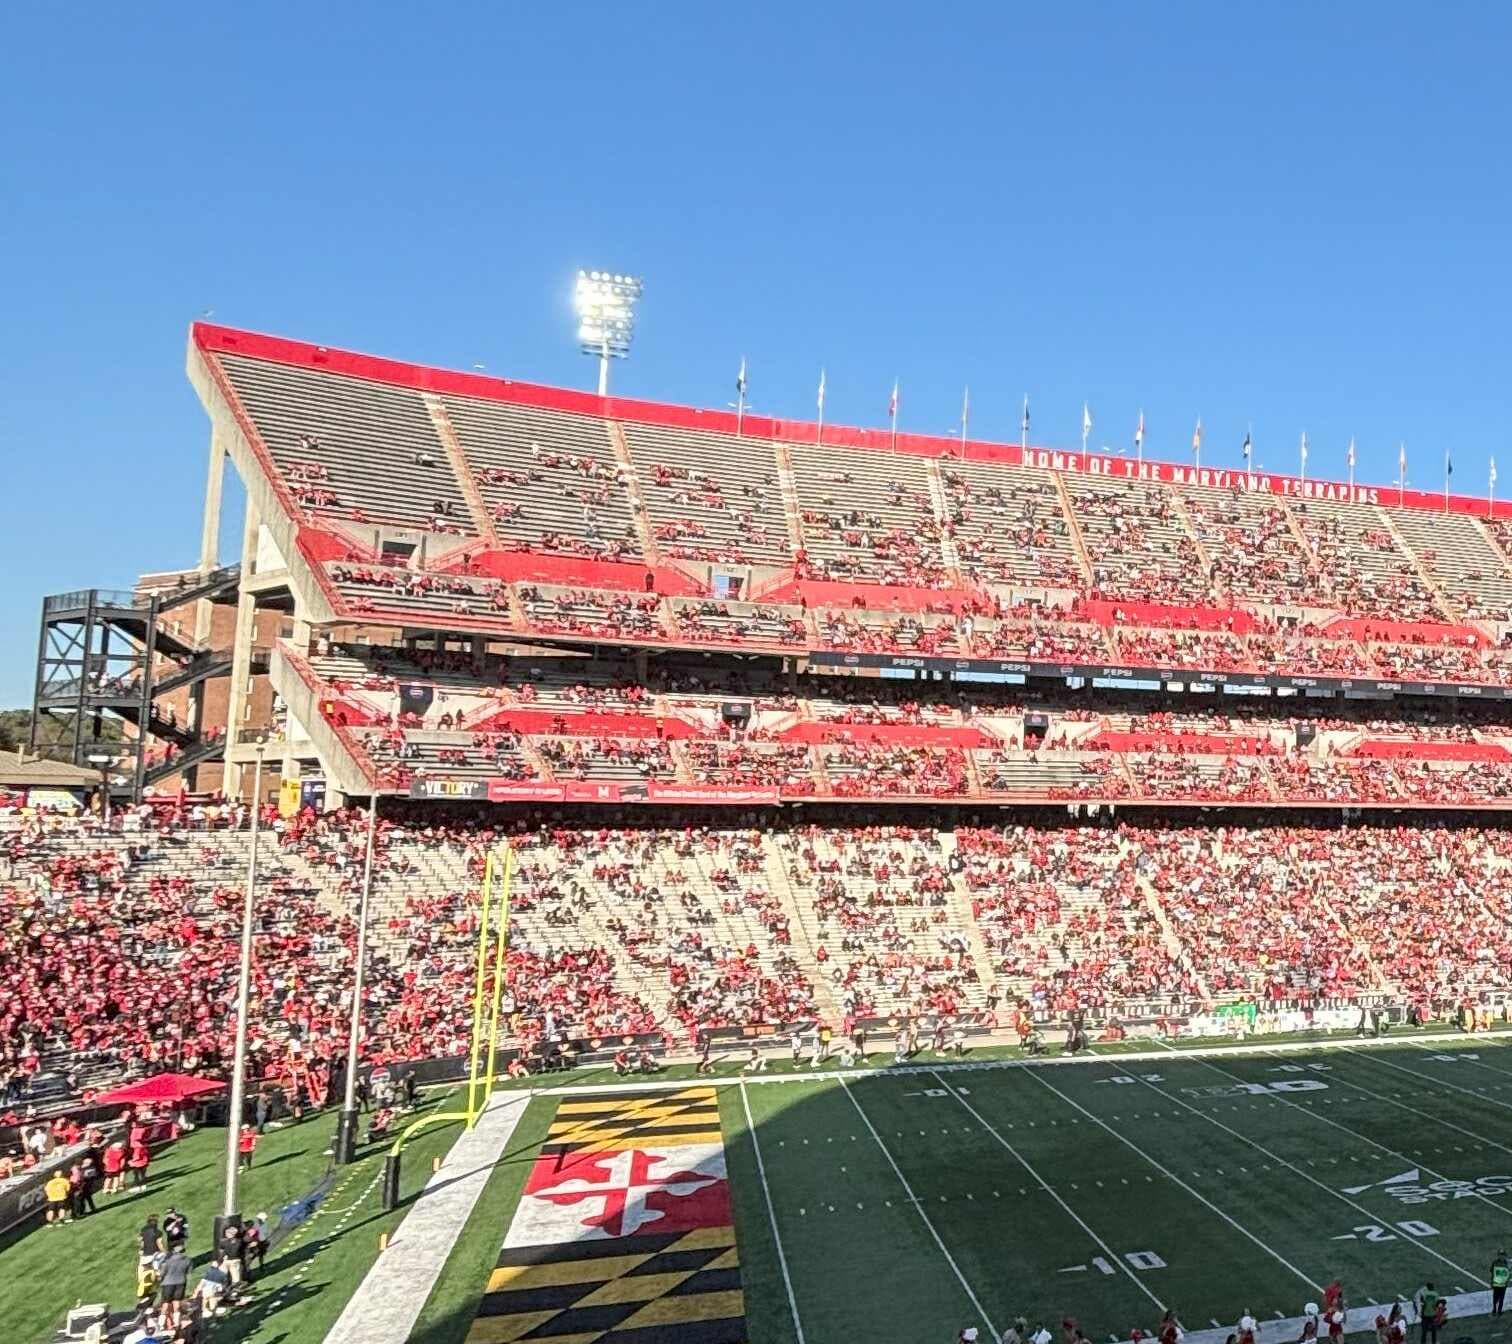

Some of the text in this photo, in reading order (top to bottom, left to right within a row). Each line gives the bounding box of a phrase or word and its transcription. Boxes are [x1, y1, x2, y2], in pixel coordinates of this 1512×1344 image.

[1024, 450, 1379, 505] HOME OF THE MARYLAND TERRAPINS
[893, 658, 924, 667] PEPSI
[1001, 663, 1031, 672] PEPSI
[1103, 668, 1133, 676] PEPSI
[1352, 1220, 1441, 1242] 20
[1092, 1251, 1168, 1275] 10
